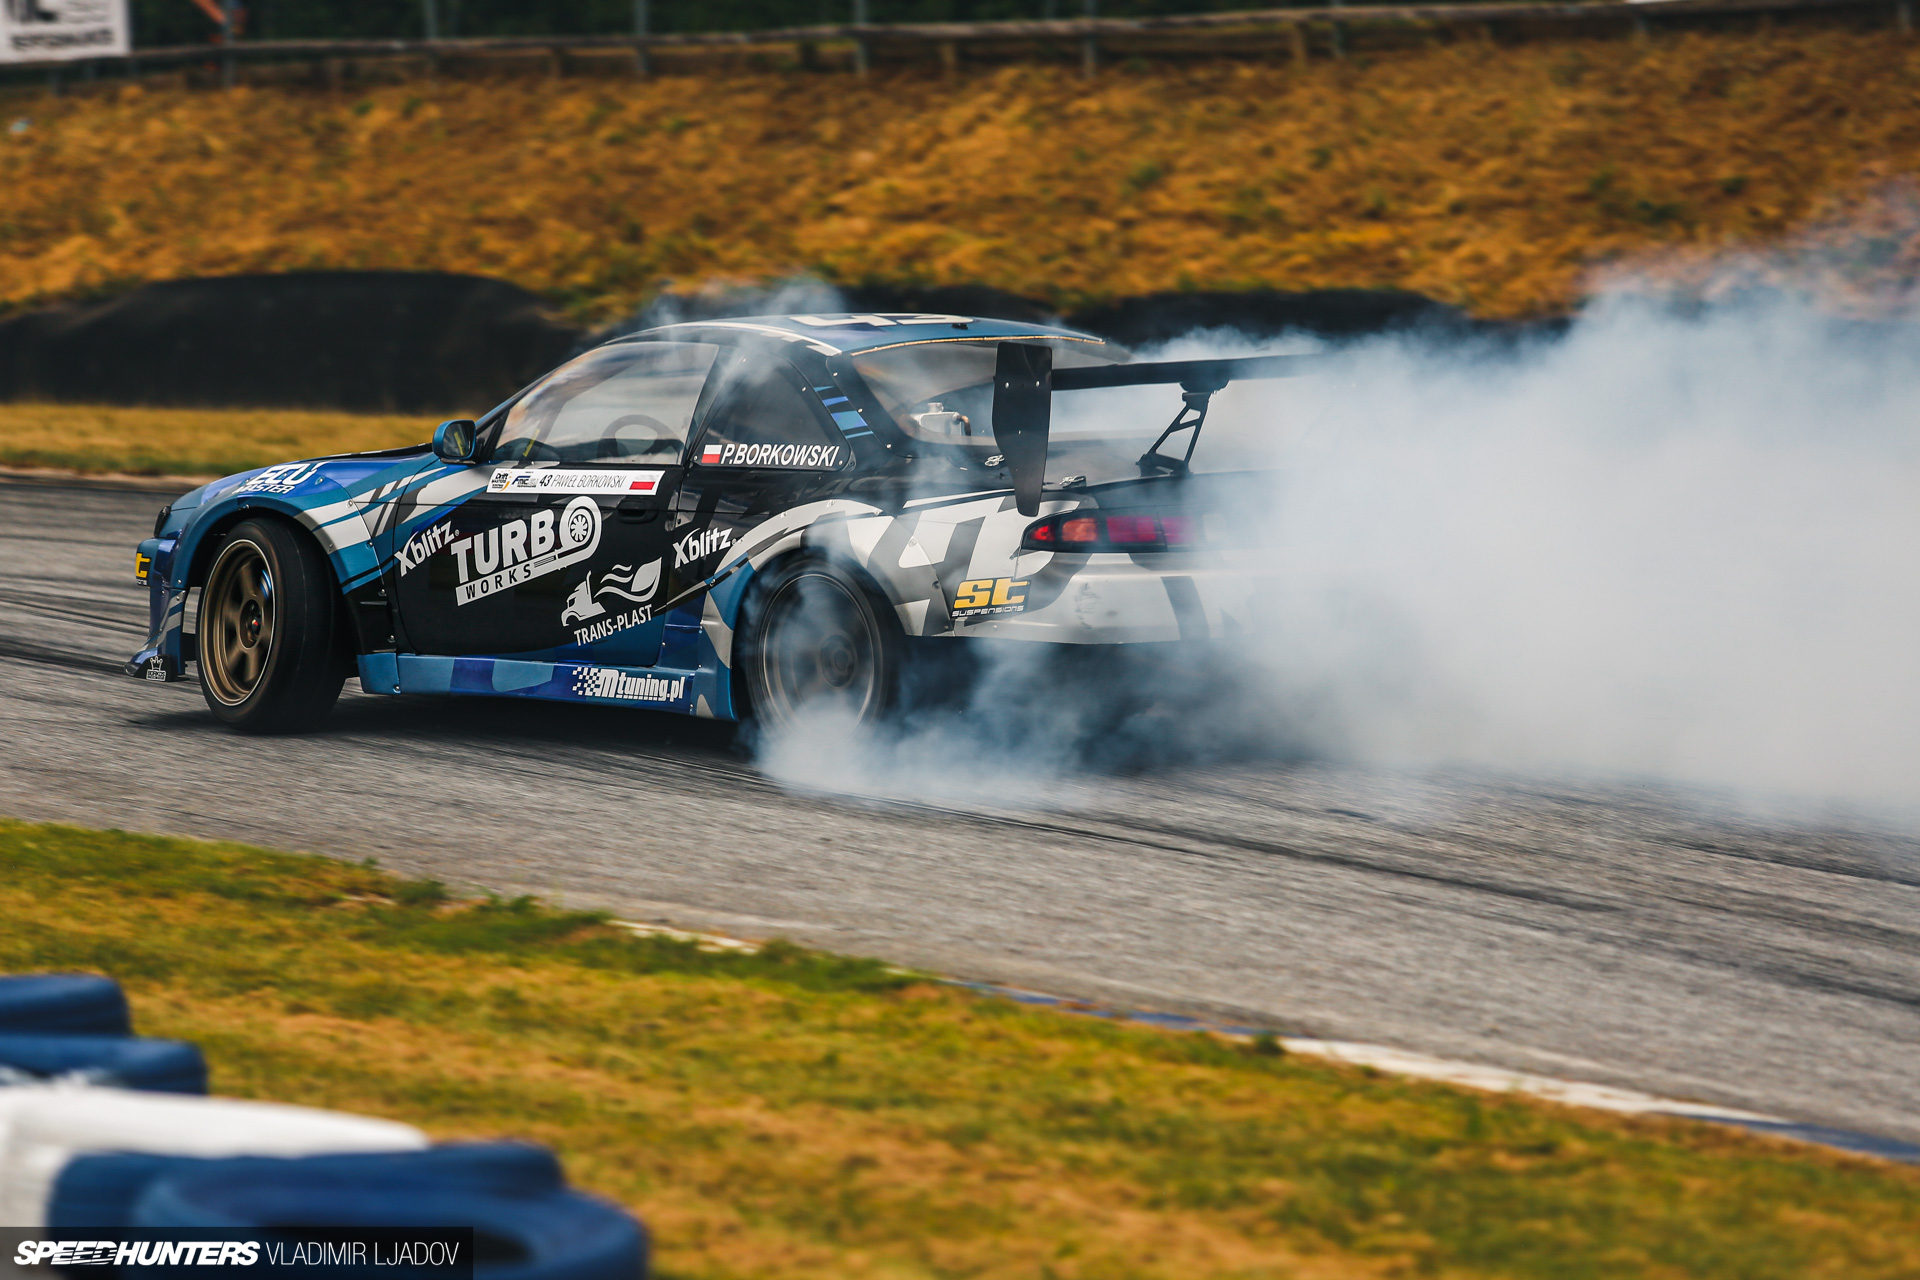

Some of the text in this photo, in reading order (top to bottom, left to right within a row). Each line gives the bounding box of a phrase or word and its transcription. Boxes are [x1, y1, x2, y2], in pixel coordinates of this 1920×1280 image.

[721, 443, 840, 467] P.BORKOWSKI
[246, 461, 329, 486] ECU
[540, 474, 553, 487] 43
[577, 475, 627, 488] BORKOWSKI
[232, 483, 295, 494] MASTER
[465, 563, 532, 600] WORKS
[573, 604, 652, 647] TRANS-PLAST
